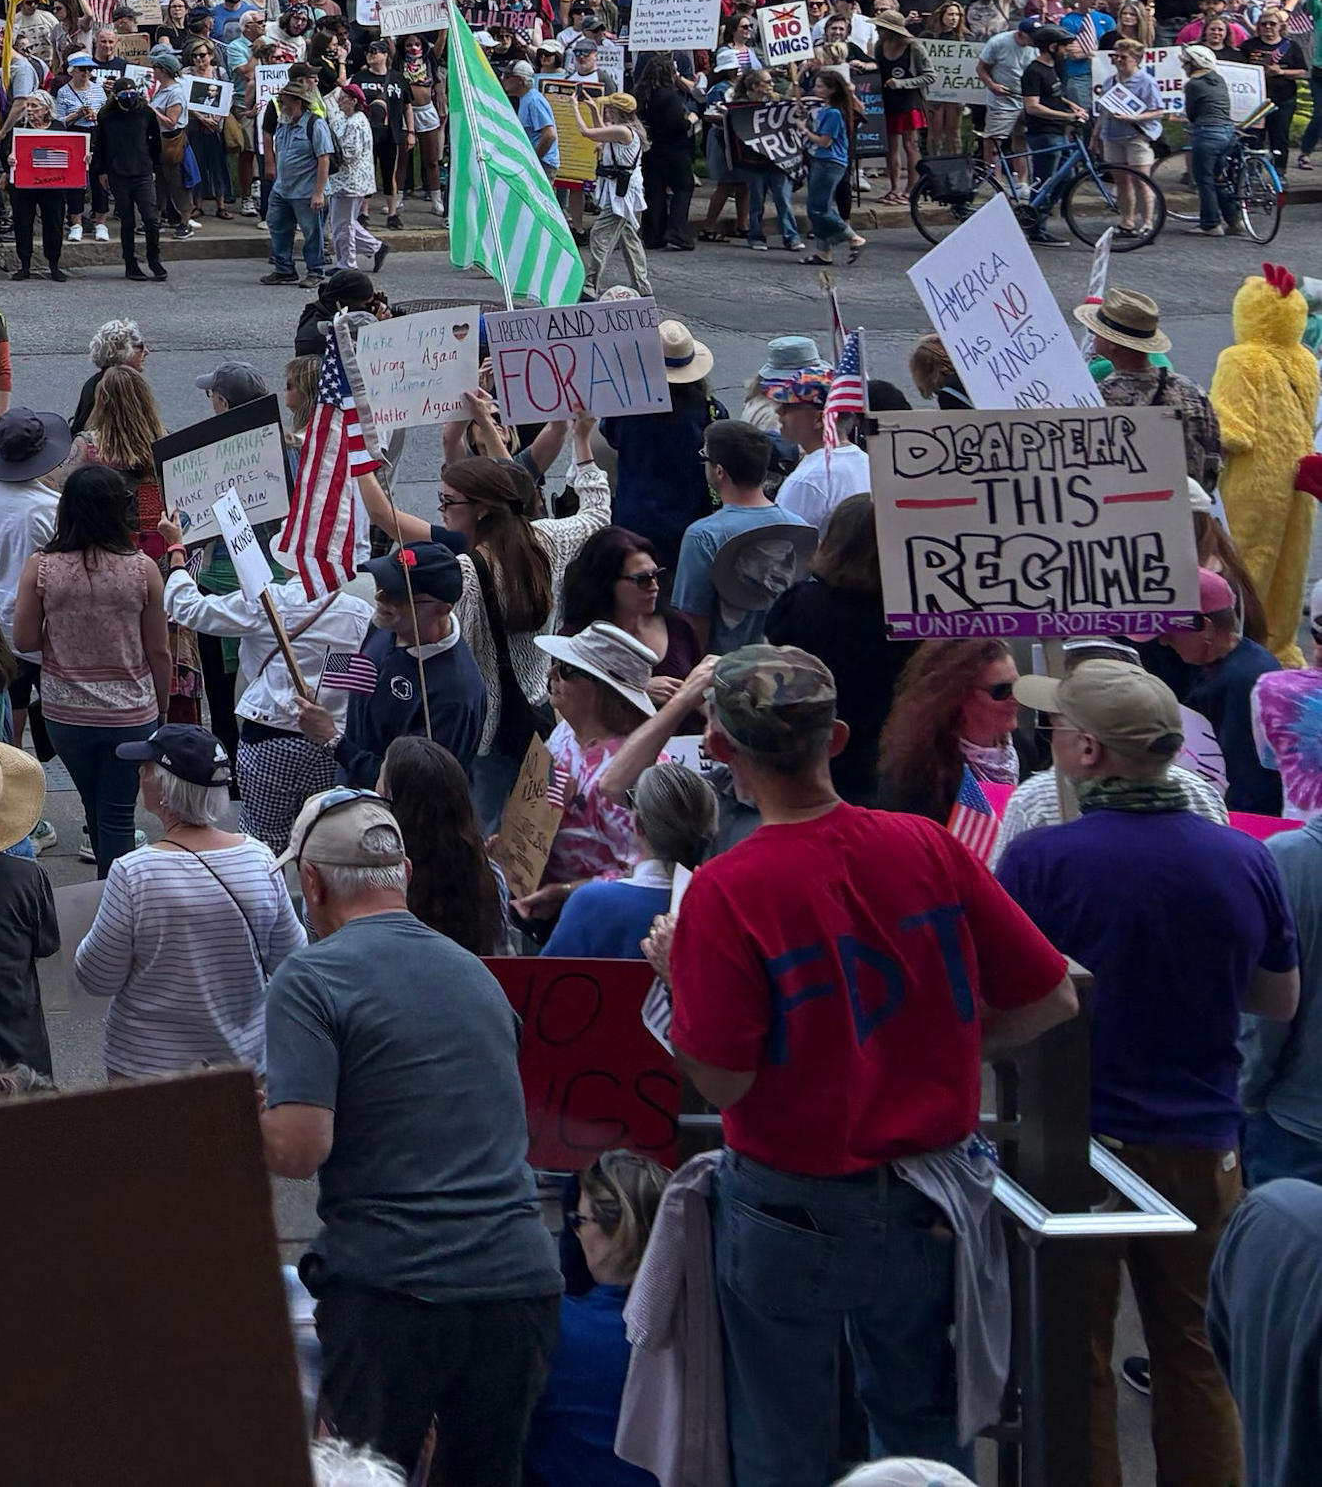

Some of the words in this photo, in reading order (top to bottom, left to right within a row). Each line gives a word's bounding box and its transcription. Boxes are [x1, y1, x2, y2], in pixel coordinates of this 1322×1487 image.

[501, 11, 538, 29] TREAT
[772, 21, 802, 41] NO
[769, 35, 810, 58] KINGS
[925, 251, 1011, 332] AMERICA
[993, 281, 1030, 334] NO
[360, 332, 394, 351] Make
[407, 321, 446, 343] Lying
[486, 314, 542, 344] LIBERTY
[547, 311, 595, 341] AND
[597, 306, 660, 335] JUSTICE
[369, 358, 407, 378] Wrong
[422, 346, 459, 371] Again
[498, 342, 587, 418] FOR
[1013, 379, 1052, 411] AND
[373, 407, 411, 425] Matter
[422, 395, 463, 417] Again
[172, 451, 208, 478] MAKE
[215, 433, 264, 461] AMERICA
[223, 453, 262, 474] AGAIN
[892, 415, 1147, 479] DISAPPEAR
[175, 489, 204, 509] MAKE
[214, 470, 259, 496] PEOPLE
[971, 474, 1100, 529] THIS
[227, 504, 243, 526] NO
[905, 531, 1176, 615] REGIME
[916, 613, 1019, 636] UNPAID
[1036, 611, 1166, 636] PROTESTER
[763, 903, 975, 1069] FDT
